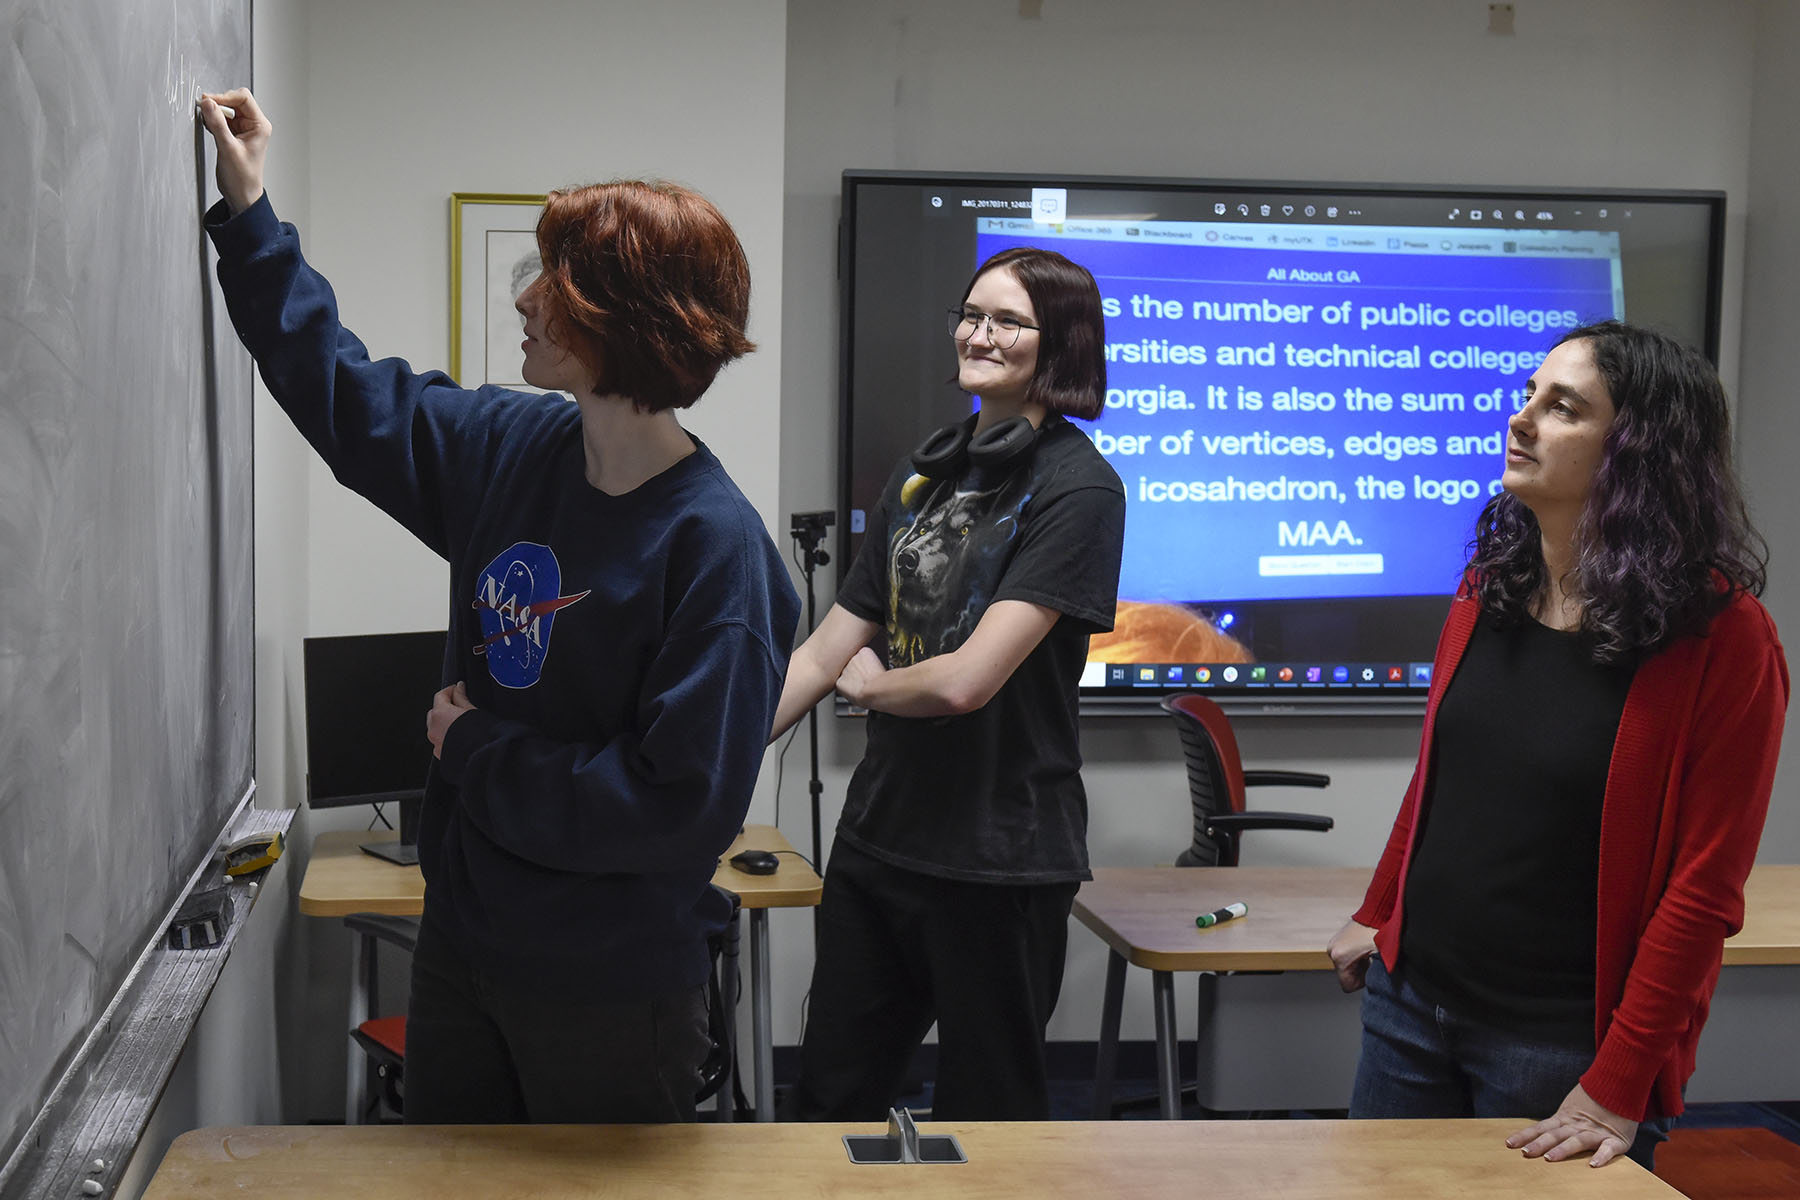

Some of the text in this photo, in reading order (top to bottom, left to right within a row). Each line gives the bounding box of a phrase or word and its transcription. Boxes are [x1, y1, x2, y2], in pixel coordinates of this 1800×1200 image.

[1144, 229, 1193, 240] Blackboard
[1223, 233, 1254, 243] Canvas
[1267, 268, 1361, 283] All About GA
[1130, 294, 1183, 319] the
[1193, 298, 1313, 323] number
[1321, 301, 1352, 324] of
[1361, 303, 1450, 330] public
[1216, 342, 1276, 367] and
[1284, 343, 1420, 368] technical
[1207, 385, 1228, 410] It
[1237, 386, 1264, 411] is
[1272, 387, 1336, 412] also
[1344, 387, 1393, 411] the
[1401, 392, 1465, 412] sum
[1473, 388, 1503, 412] of
[1160, 430, 1194, 455] of
[1202, 430, 1335, 459] vertices,
[1344, 431, 1438, 461] edges
[1446, 431, 1502, 455] and
[1139, 475, 1346, 504] icosahedron,
[1355, 475, 1405, 500] the
[1414, 475, 1480, 505] logo
[1278, 520, 1363, 546] MAA.
[478, 573, 543, 649] NASA
